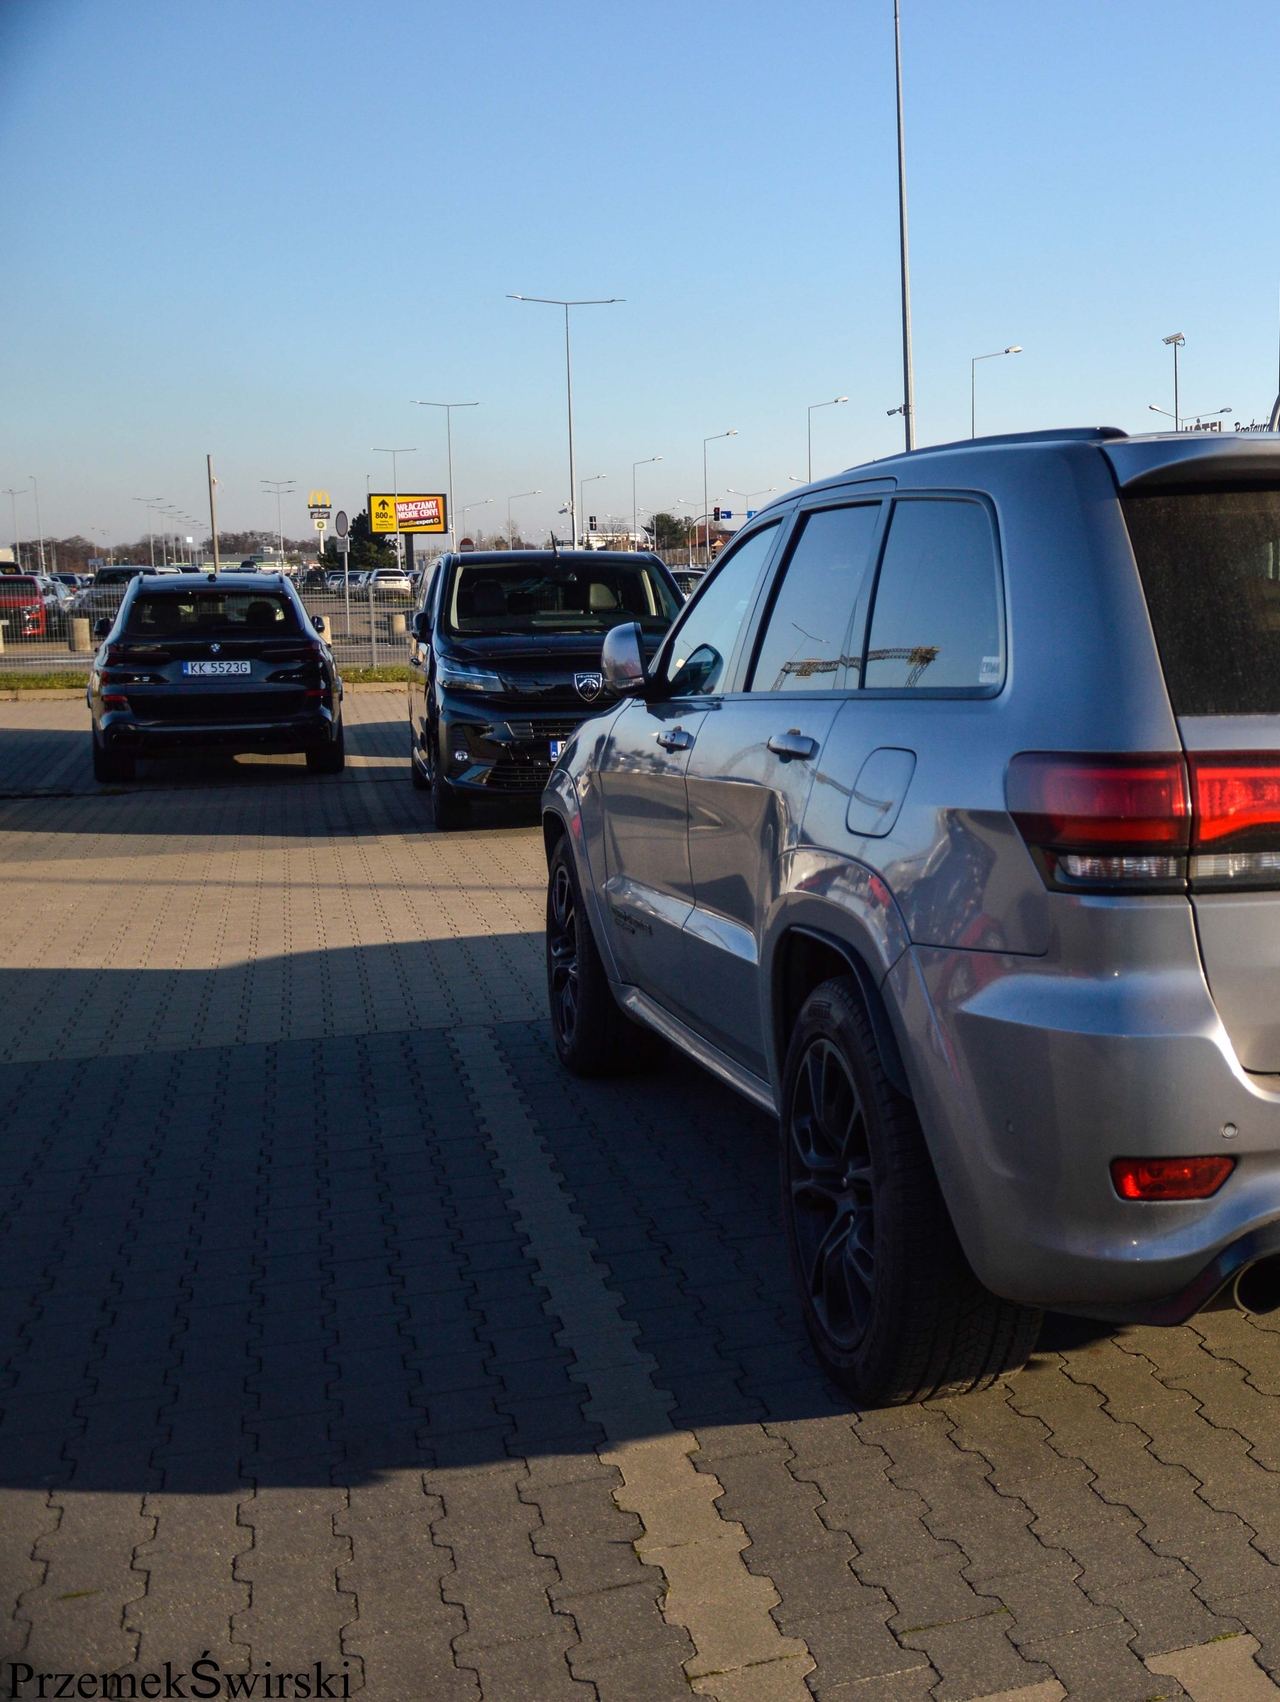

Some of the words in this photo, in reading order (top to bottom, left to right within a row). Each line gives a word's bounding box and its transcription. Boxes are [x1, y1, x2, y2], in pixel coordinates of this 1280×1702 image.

[398, 510, 419, 519] NISKIE
[419, 508, 439, 517] CENY!
[190, 662, 210, 673] KK
[211, 662, 248, 673] 5523G
